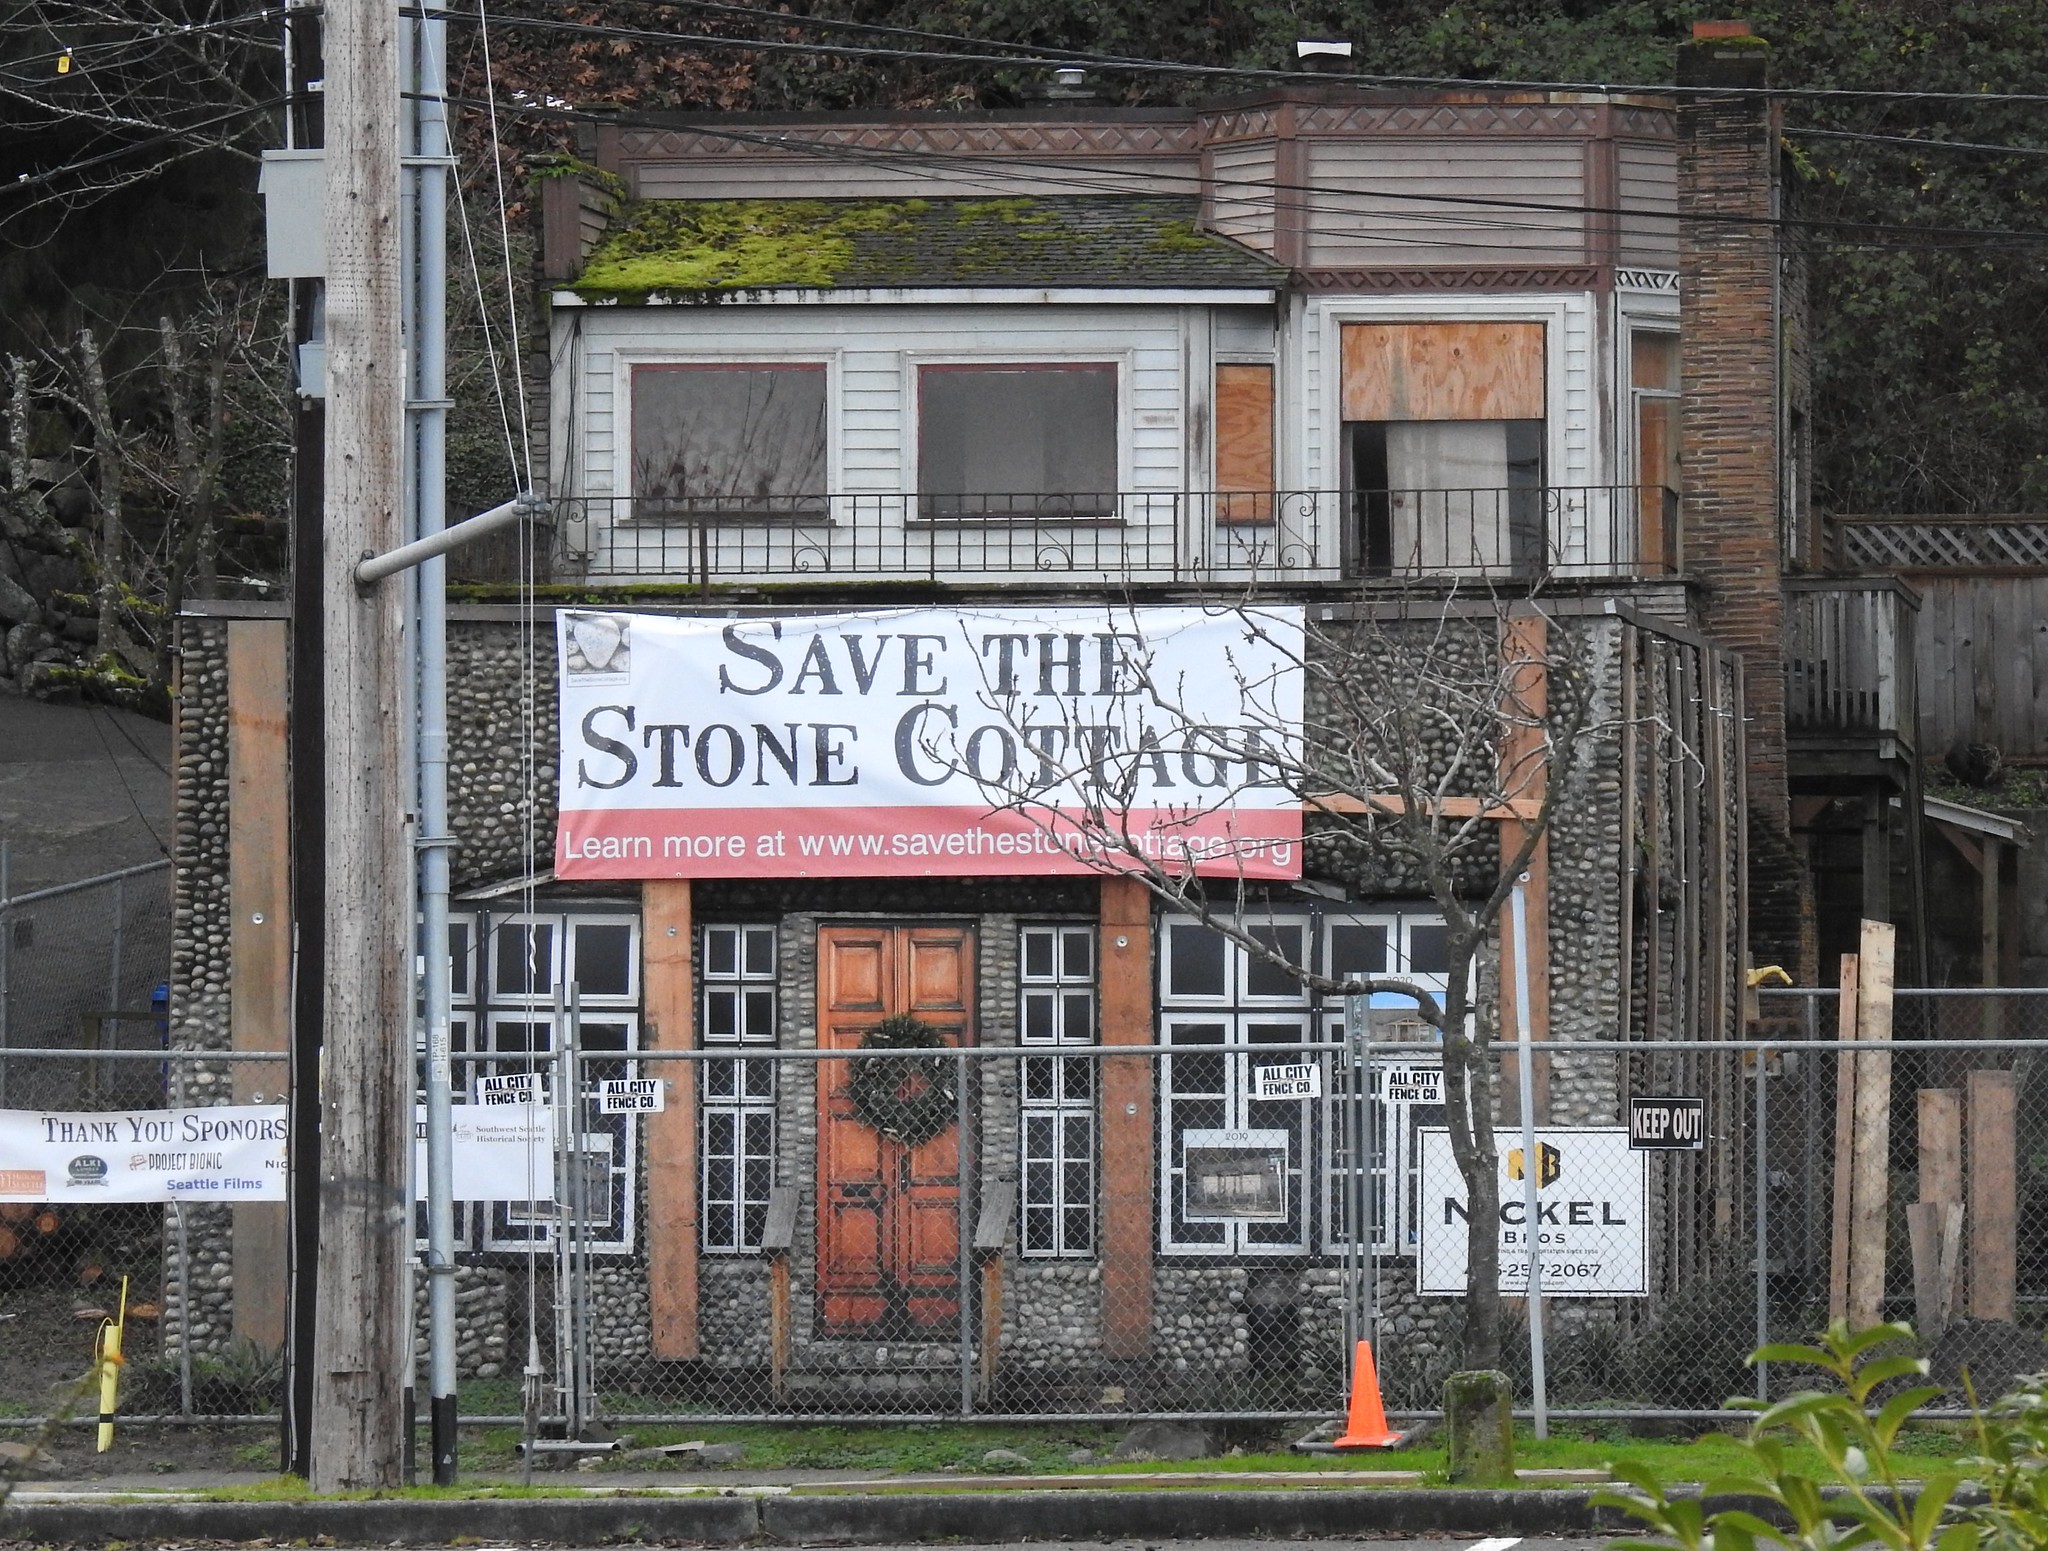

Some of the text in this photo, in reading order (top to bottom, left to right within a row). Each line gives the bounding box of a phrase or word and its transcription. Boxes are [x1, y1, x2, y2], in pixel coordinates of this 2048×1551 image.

[719, 620, 1143, 696] SAVE THE
[578, 705, 859, 789] STONE
[564, 831, 652, 859] Learn
[664, 834, 746, 857] more
[756, 830, 786, 857] at
[1263, 1065, 1312, 1081] ALL CITY
[1389, 1072, 1440, 1085] ALL CITY
[485, 1075, 533, 1091] ALL CITY
[607, 1080, 656, 1095] ALL CITY
[1263, 1081, 1314, 1096] FENCE CO.
[485, 1093, 516, 1106] FENCE
[1389, 1088, 1441, 1100] FENCE CO.
[607, 1096, 657, 1109] FENCE CO.
[42, 1114, 288, 1143] THANK YOU SPONORS
[476, 1125, 518, 1133] Southwest
[1633, 1107, 1701, 1140] KEEP OUT
[476, 1135, 516, 1143] Historical
[75, 1159, 101, 1168] ALKI
[149, 1152, 223, 1171] PROJECT BIONIC
[167, 1178, 263, 1190] Seattle Films
[1444, 1197, 1627, 1226] NCKEL
